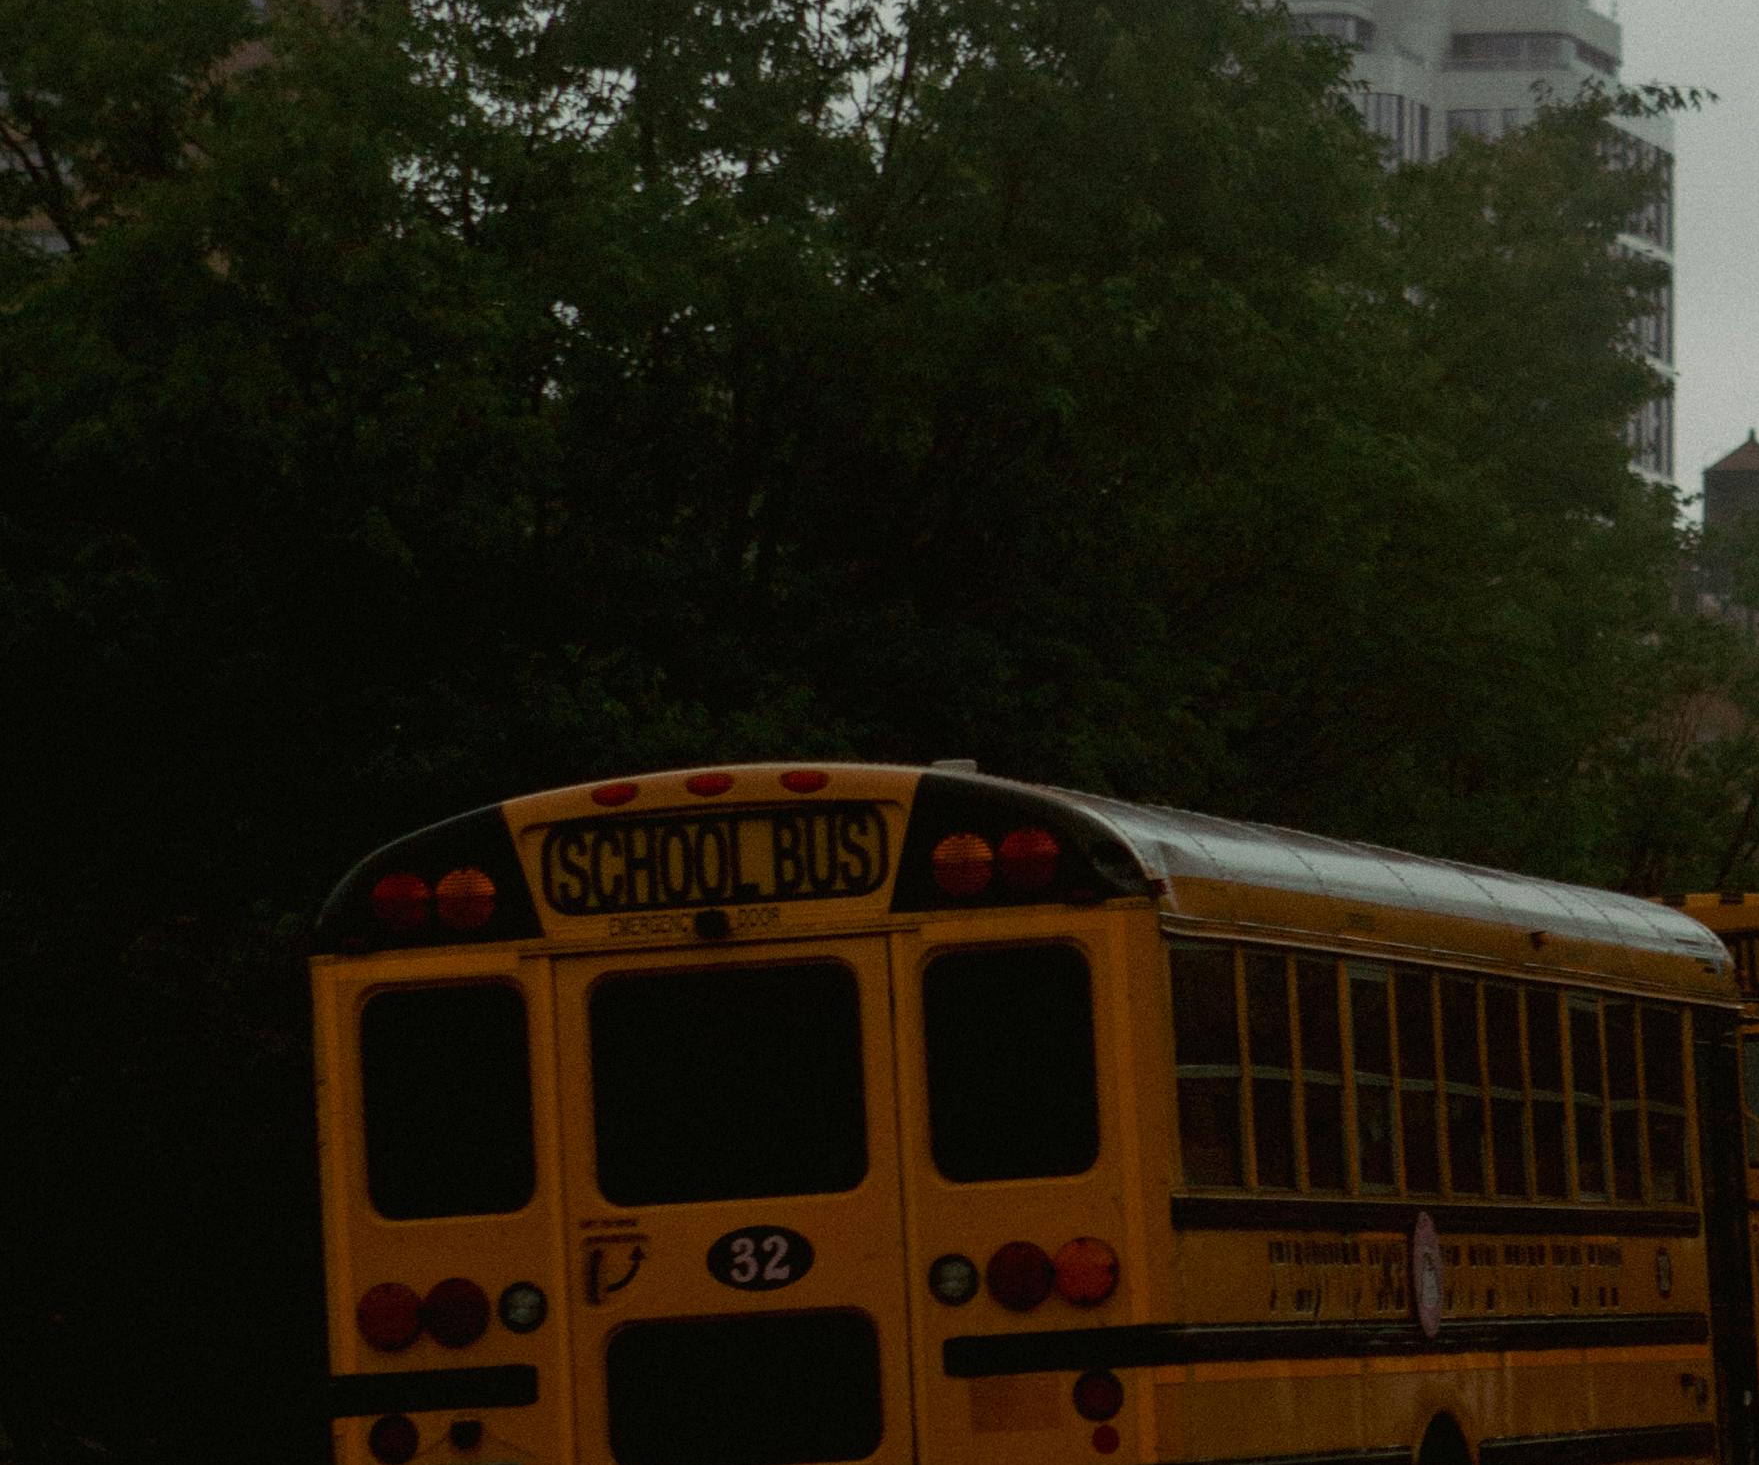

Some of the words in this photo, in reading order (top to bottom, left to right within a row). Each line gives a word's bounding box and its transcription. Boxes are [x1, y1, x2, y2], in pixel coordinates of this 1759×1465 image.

[557, 818, 761, 910] SCHOOL
[774, 802, 872, 898] BUS
[609, 913, 691, 936] EMERGENC
[737, 906, 779, 928] DOOR
[730, 1234, 791, 1283] 32
